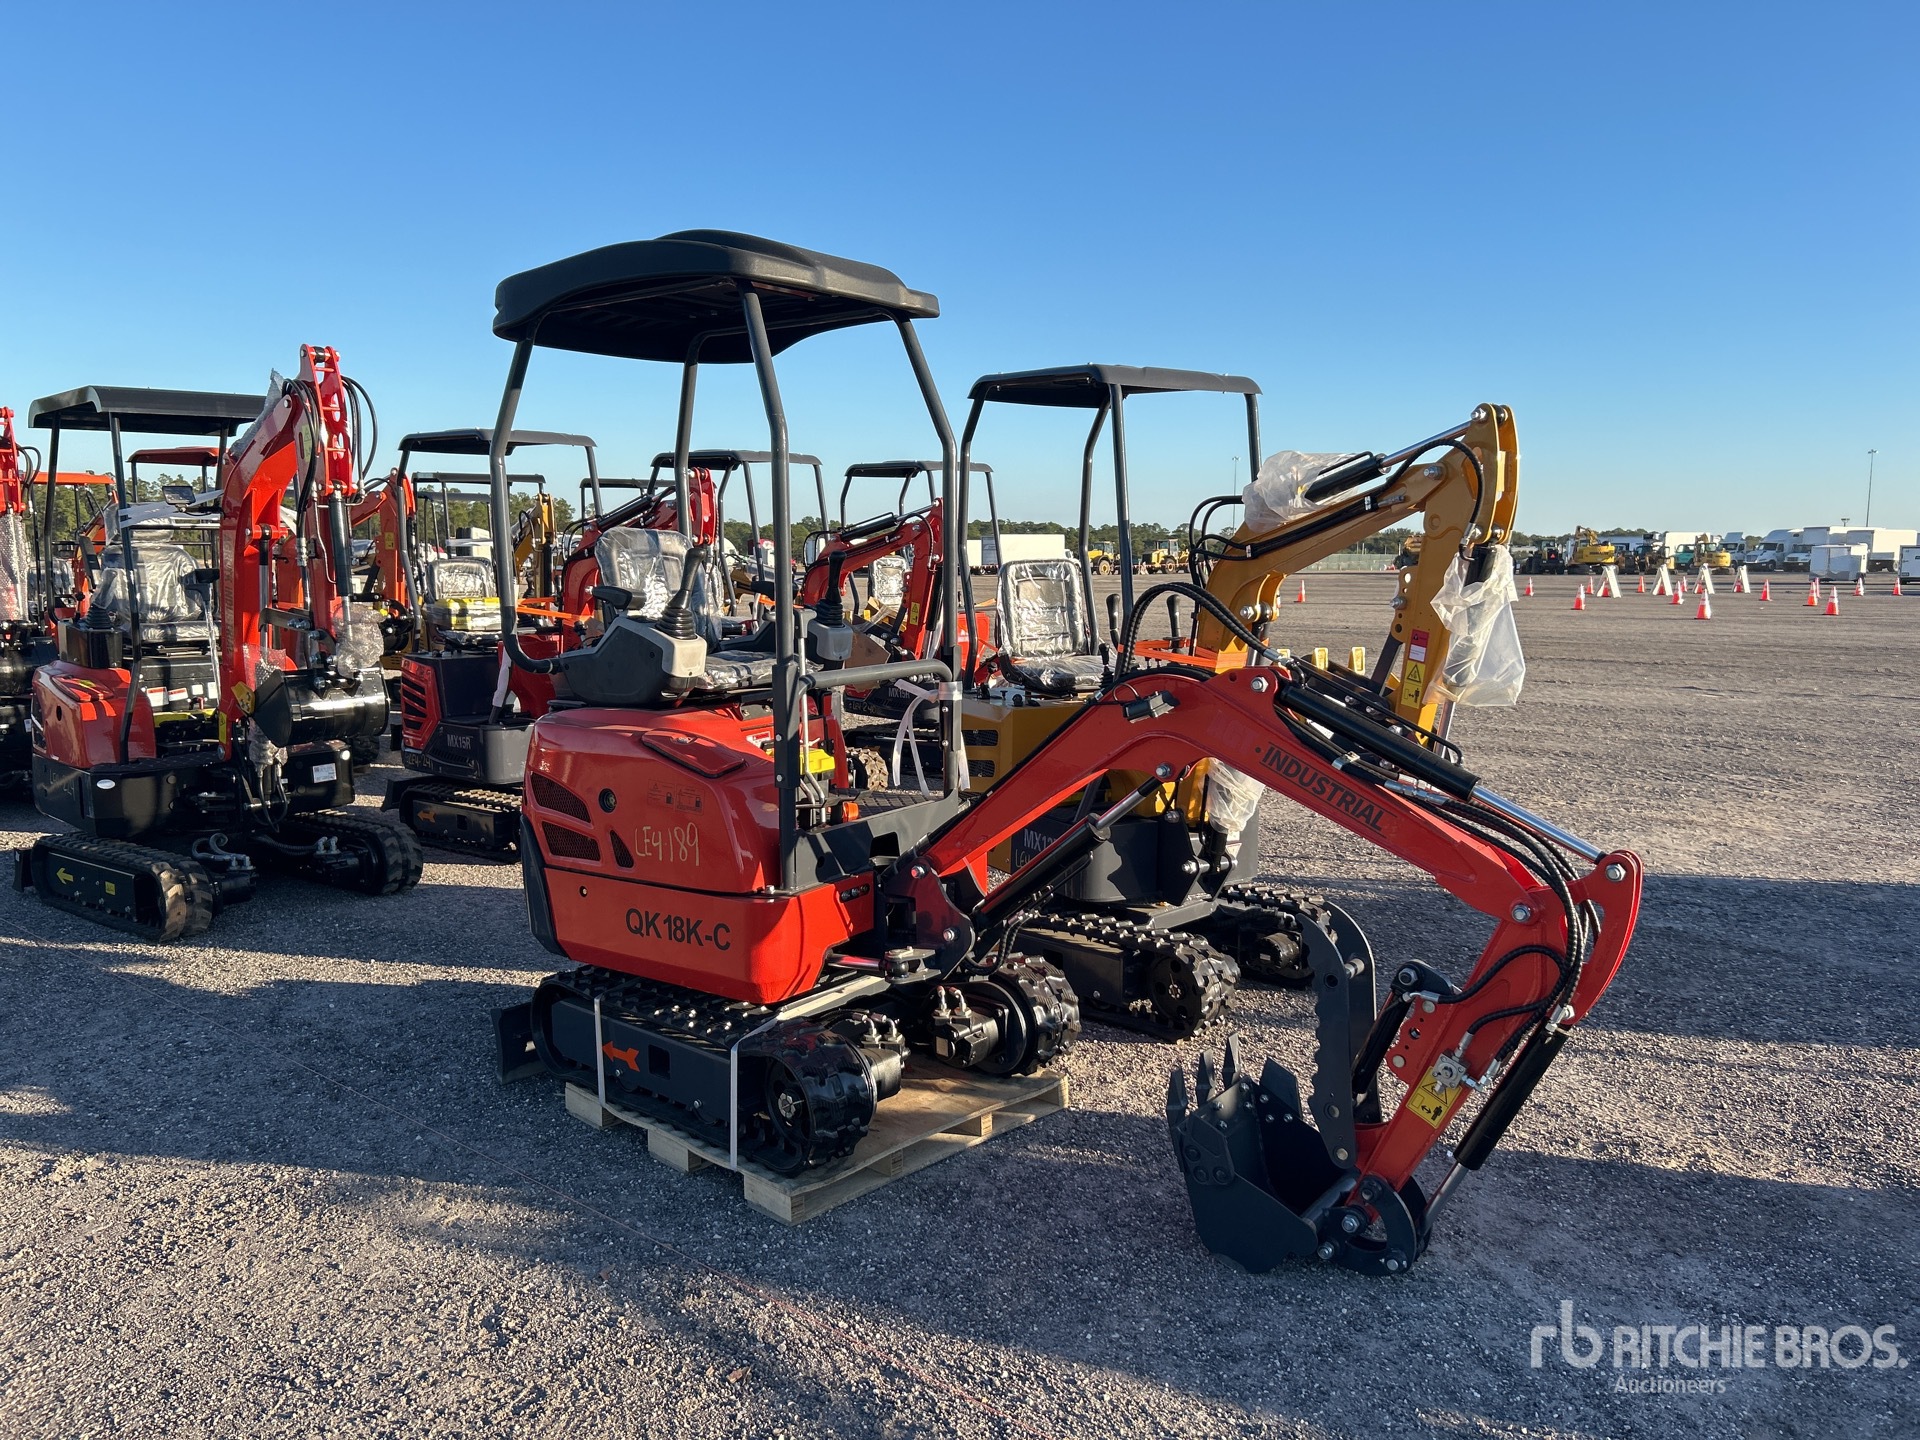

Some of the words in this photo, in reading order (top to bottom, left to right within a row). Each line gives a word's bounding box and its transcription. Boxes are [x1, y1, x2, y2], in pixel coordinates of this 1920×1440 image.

[447, 734, 471, 749] MX15R
[1262, 746, 1385, 831] INDUSTRIAL
[625, 908, 731, 951] QK18K-C
